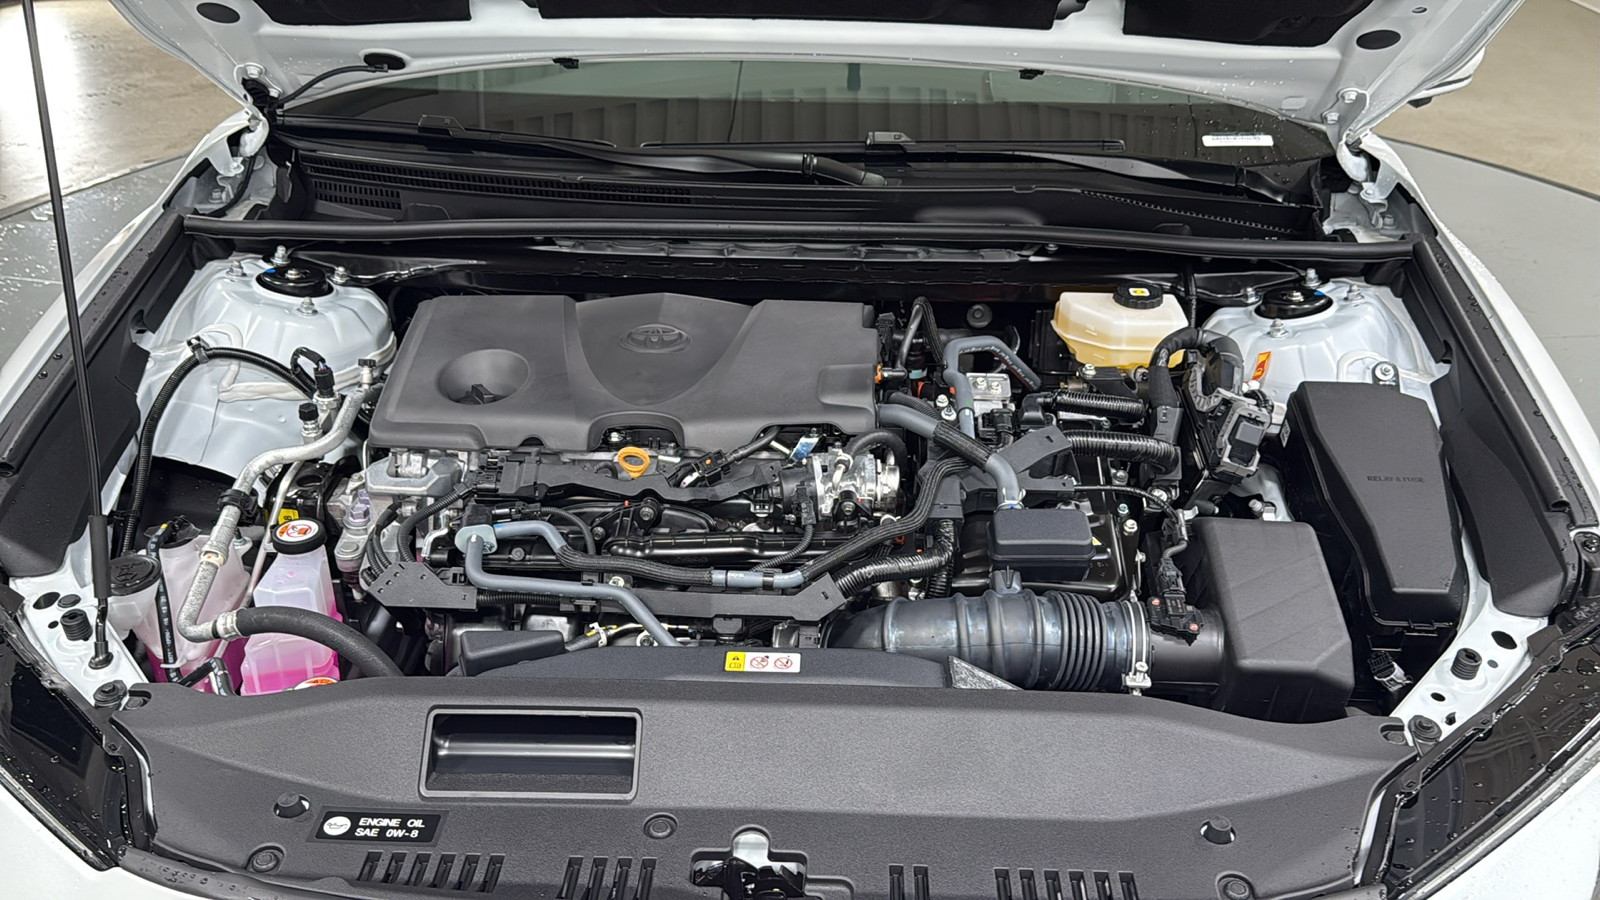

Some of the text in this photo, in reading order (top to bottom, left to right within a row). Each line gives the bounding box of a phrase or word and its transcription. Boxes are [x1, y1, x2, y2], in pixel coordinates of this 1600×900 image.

[358, 817, 425, 828] ENGINE OIL
[354, 828, 418, 838] SAE 0W-8
